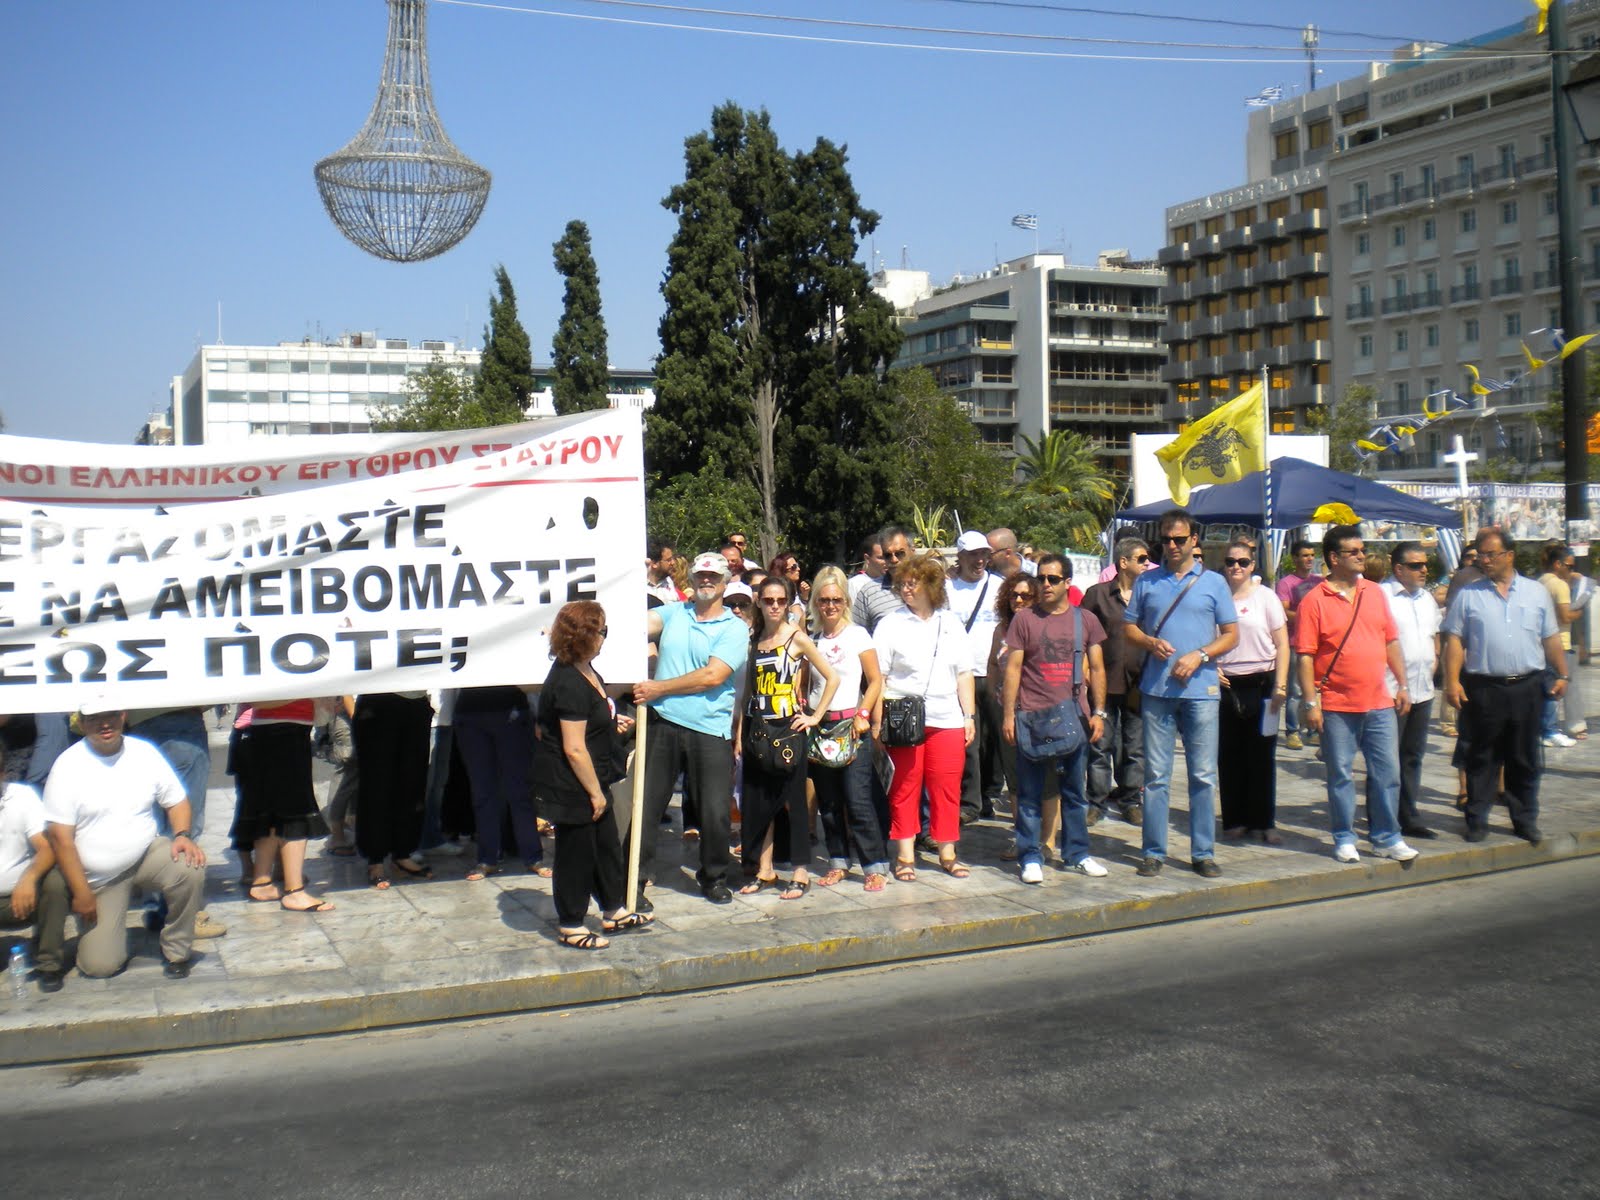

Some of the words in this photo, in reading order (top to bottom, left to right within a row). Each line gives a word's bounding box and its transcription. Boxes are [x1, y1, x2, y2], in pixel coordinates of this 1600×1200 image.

[69, 464, 288, 489] ΕΛΛΗΝΙΚΟΥ
[298, 444, 460, 480] ΕΡΥΘΡΟΥ
[471, 435, 624, 471] ΣΤΑΥΡΟΥ
[1424, 484, 1493, 498] ΕΠΙΚΙΝΥΝΟΙ
[40, 581, 129, 626] ΝΑ
[148, 558, 597, 620] ΑΜΕΙΒΟΜΑΣΤΕ
[0, 639, 168, 686] ΕΩΣ
[204, 628, 468, 678] ΠΟΤΕ;
